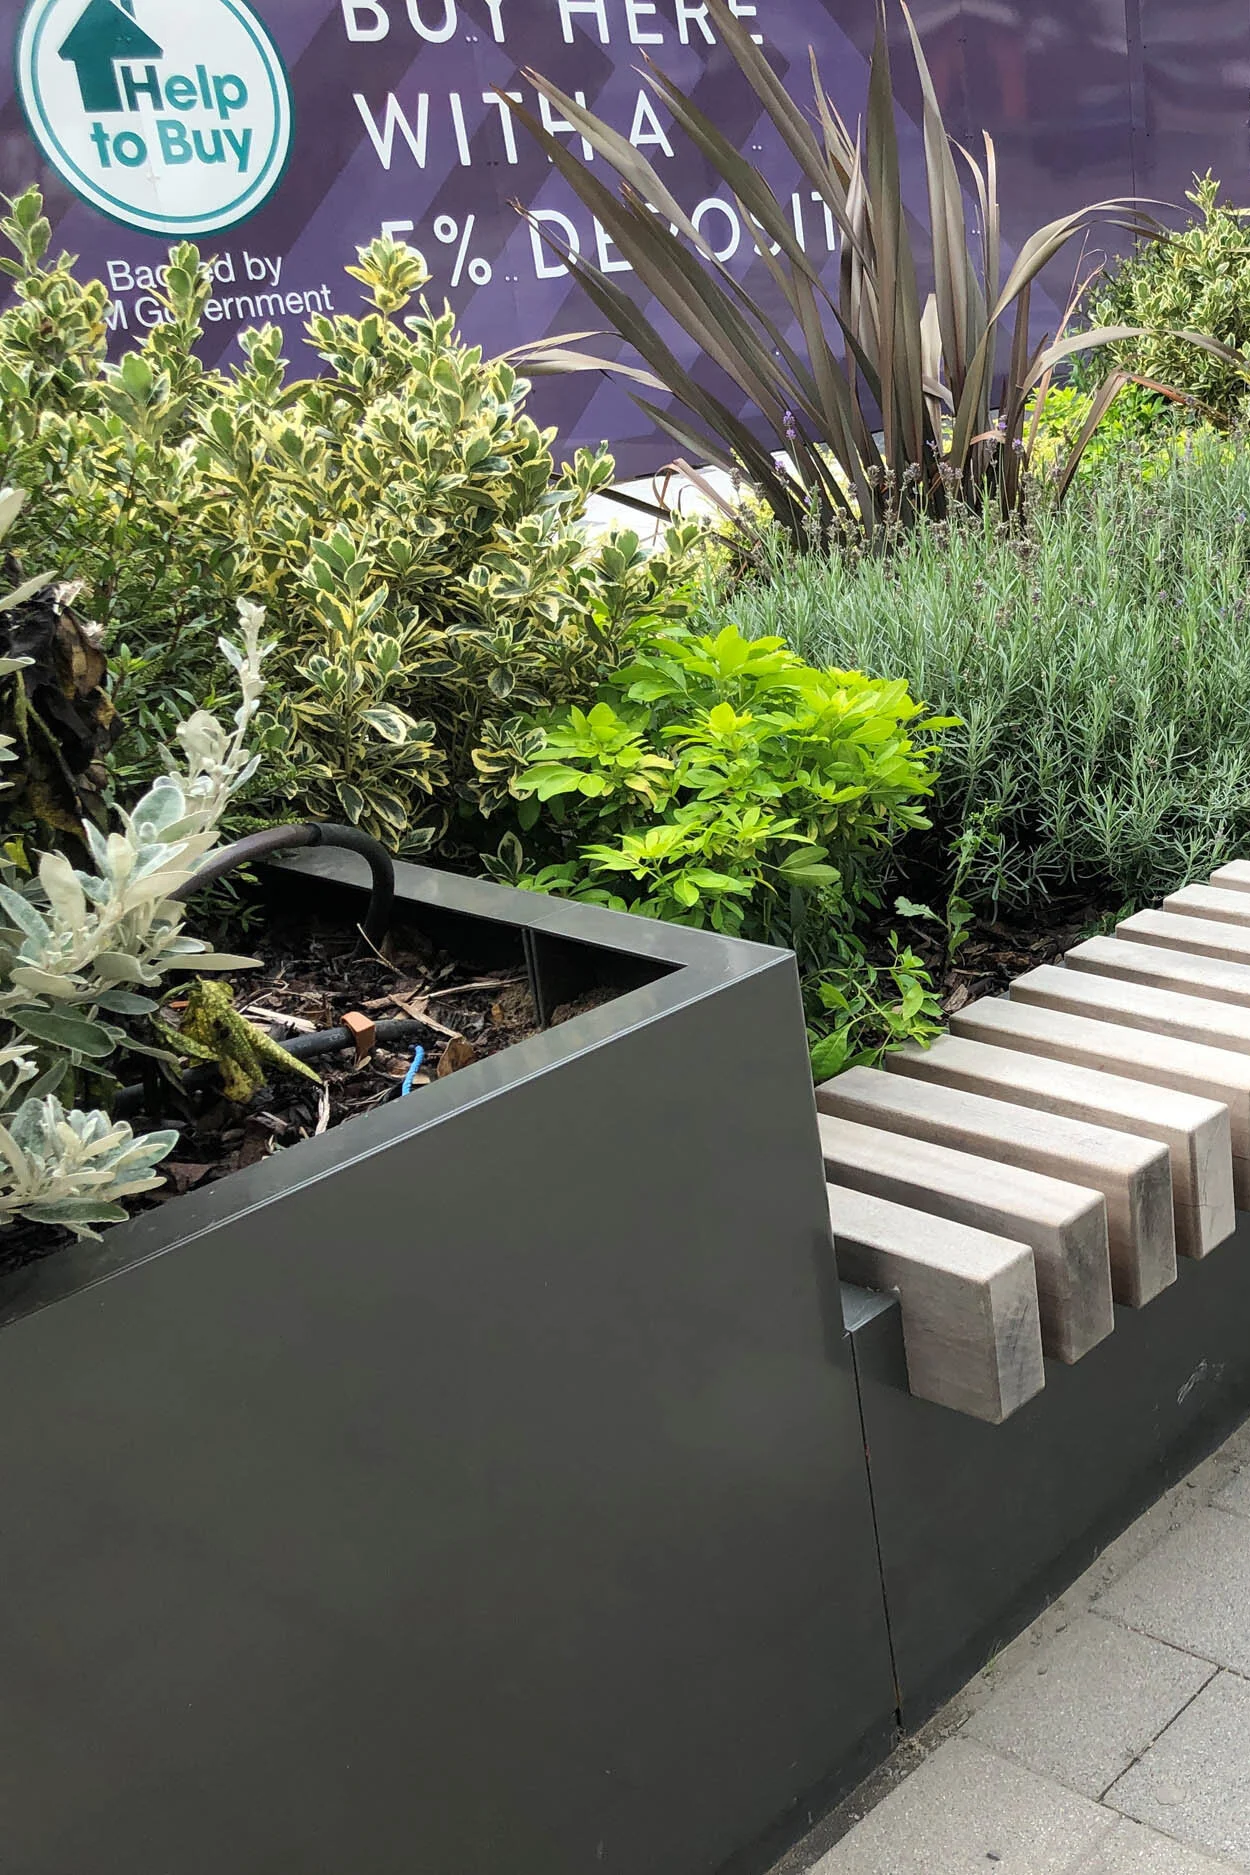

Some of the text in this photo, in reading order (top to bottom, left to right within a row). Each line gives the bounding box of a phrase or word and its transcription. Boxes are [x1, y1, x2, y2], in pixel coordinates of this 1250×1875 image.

[120, 64, 248, 120] Help
[90, 120, 252, 173] to Buy
[353, 89, 674, 170] WITH A
[528, 191, 835, 279] DEOIT
[106, 250, 283, 292] Baced by
[135, 284, 335, 328] Goernment
